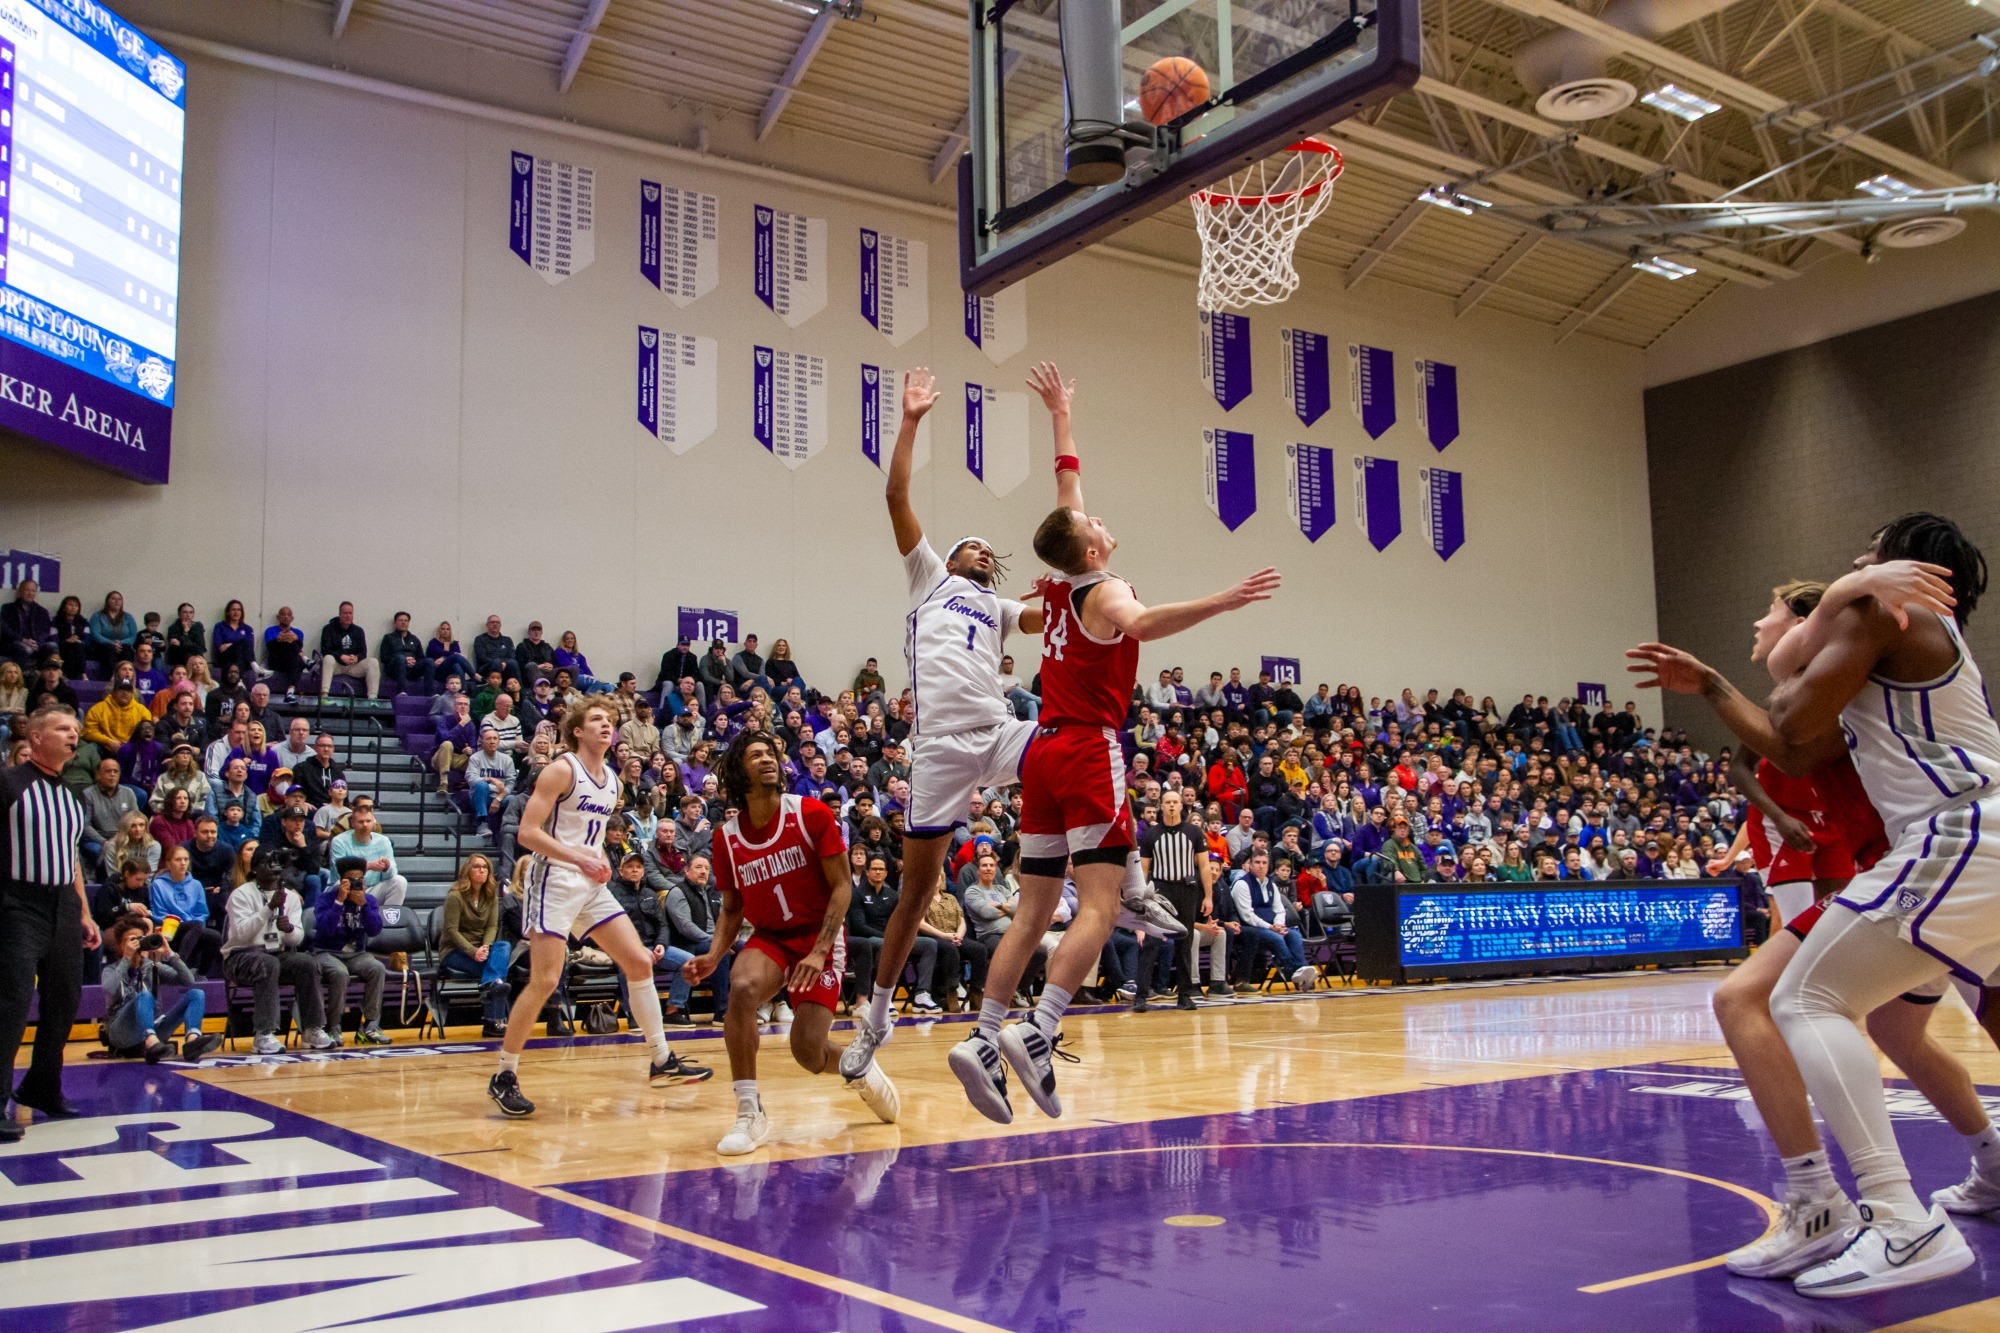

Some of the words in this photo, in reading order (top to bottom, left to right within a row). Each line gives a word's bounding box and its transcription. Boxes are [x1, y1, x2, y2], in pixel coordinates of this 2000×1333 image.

[558, 163, 572, 171] 1972
[665, 233, 677, 241] 1971
[50, 311, 132, 367] LOUNGE
[2, 562, 40, 592] 111
[697, 618, 729, 643] 112
[966, 625, 976, 651] 1
[1041, 601, 1068, 662] 24
[1274, 664, 1295, 684] 113
[1586, 690, 1603, 707] 114
[584, 819, 601, 846] 11
[738, 857, 770, 887] SOUTH
[766, 845, 808, 878] DAKOTA
[773, 883, 793, 922] 1
[1450, 904, 1543, 931] TIFFANY
[1547, 900, 1621, 928] SPORTS
[1622, 899, 1699, 924] LOUNGE
